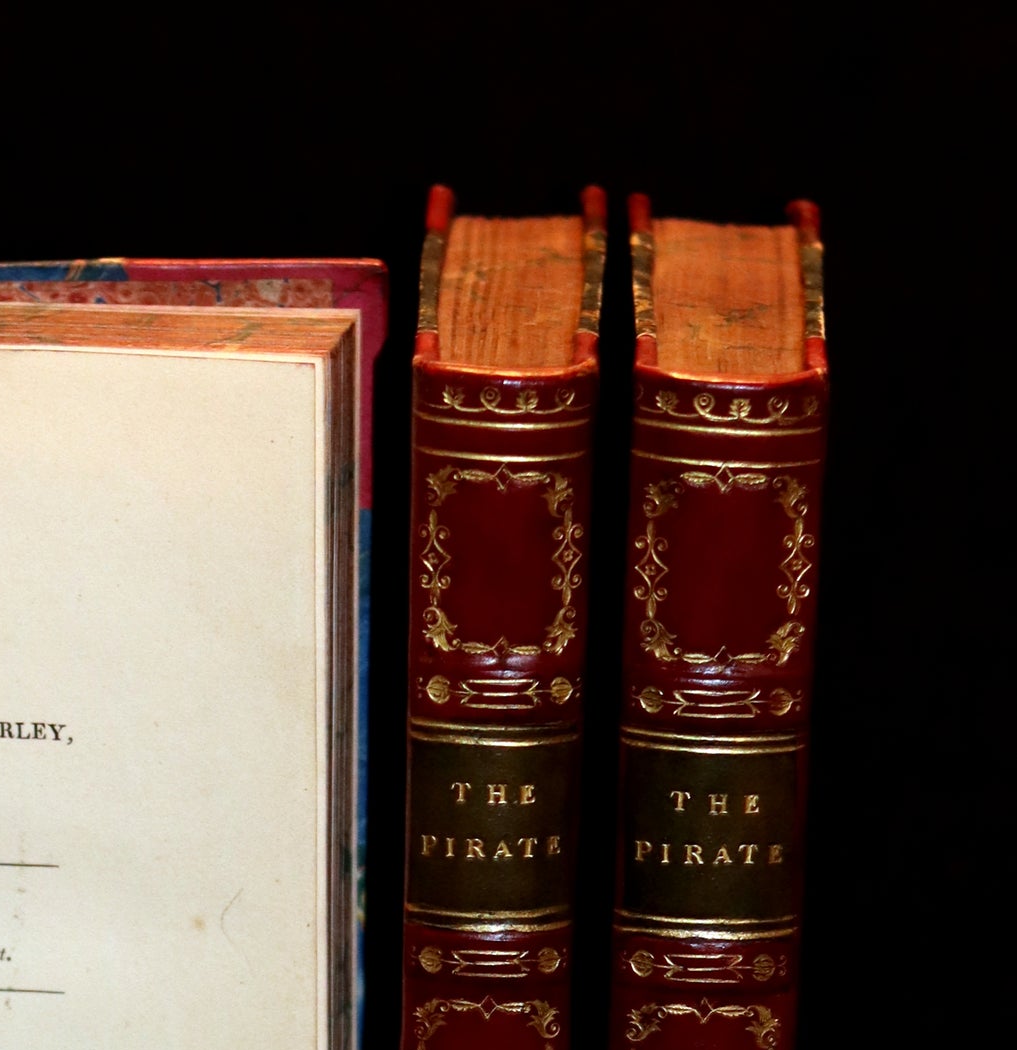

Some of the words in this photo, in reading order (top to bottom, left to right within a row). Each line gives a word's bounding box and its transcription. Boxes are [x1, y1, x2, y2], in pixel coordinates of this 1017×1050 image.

[450, 782, 537, 805] THE
[670, 791, 761, 815] THE
[420, 834, 562, 860] PIRATE
[634, 840, 784, 866] PIRATE
